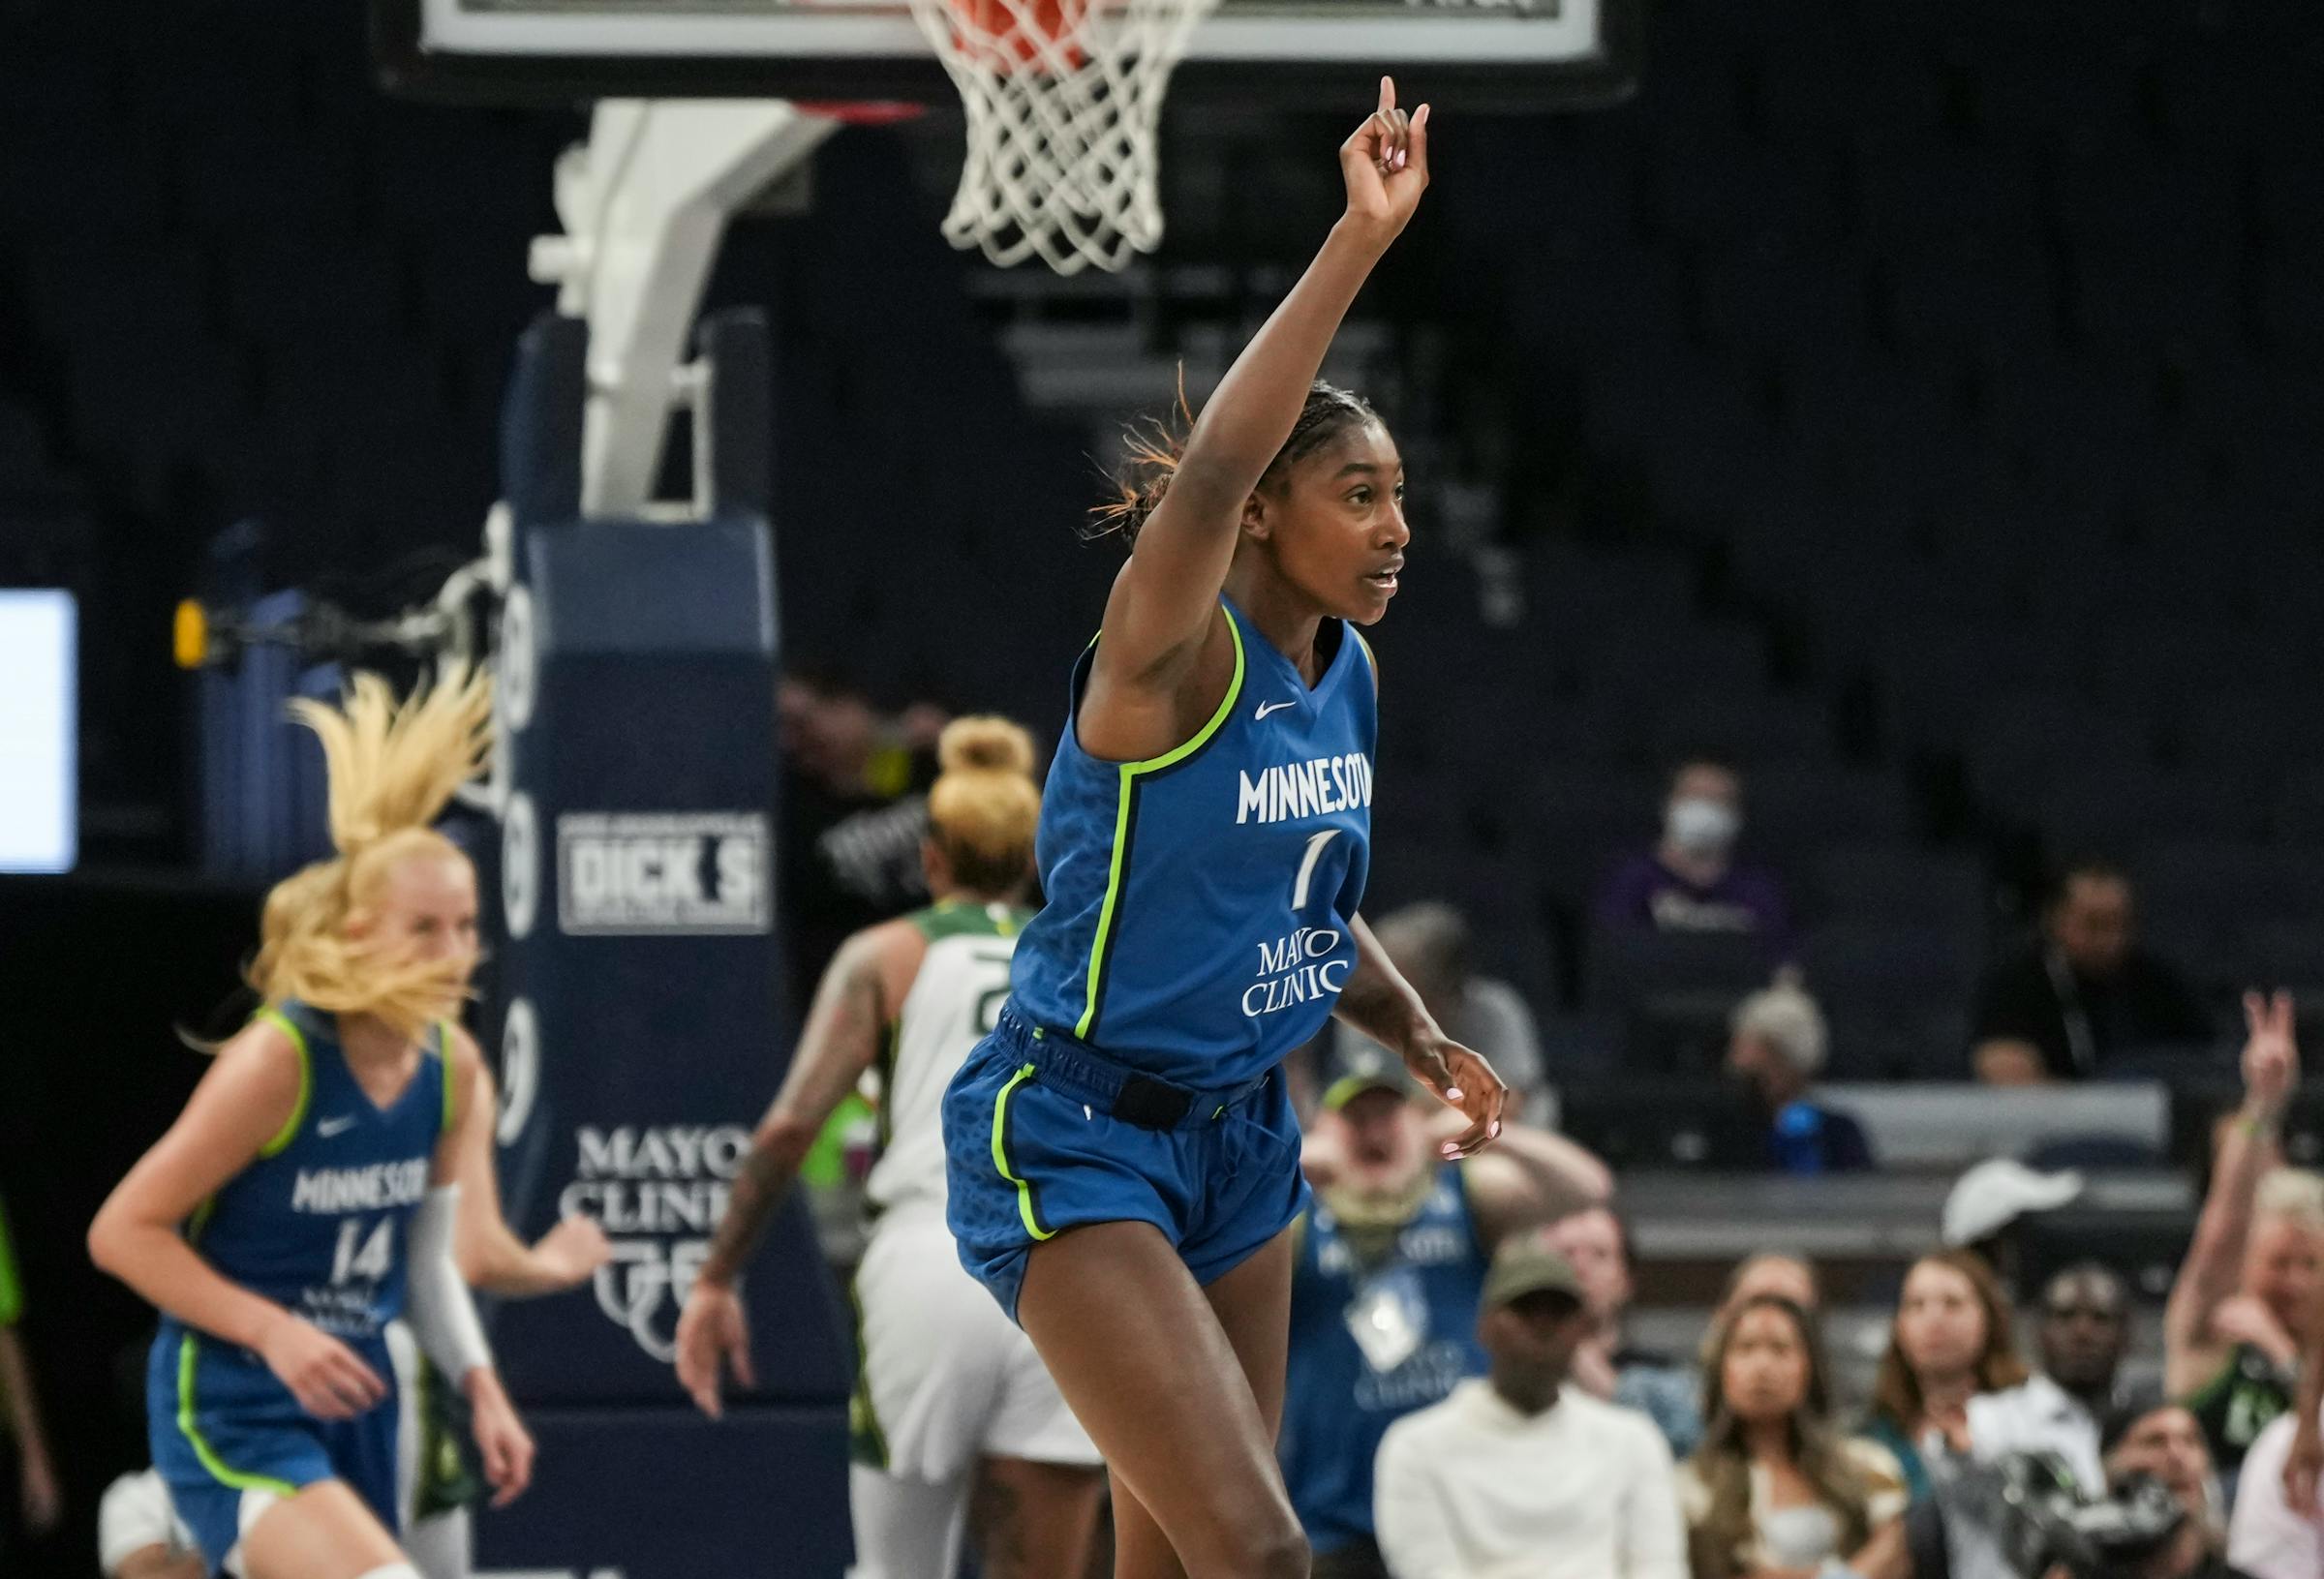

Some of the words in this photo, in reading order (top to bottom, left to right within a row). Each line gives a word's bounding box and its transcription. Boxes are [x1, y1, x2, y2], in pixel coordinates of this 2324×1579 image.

[1291, 829, 1342, 911] 1
[1256, 927, 1339, 976] MAYO
[1241, 959, 1348, 1017] CLINIC
[577, 1126, 752, 1178] MAYO
[559, 1180, 731, 1232] CLINI
[330, 1217, 393, 1286] 14
